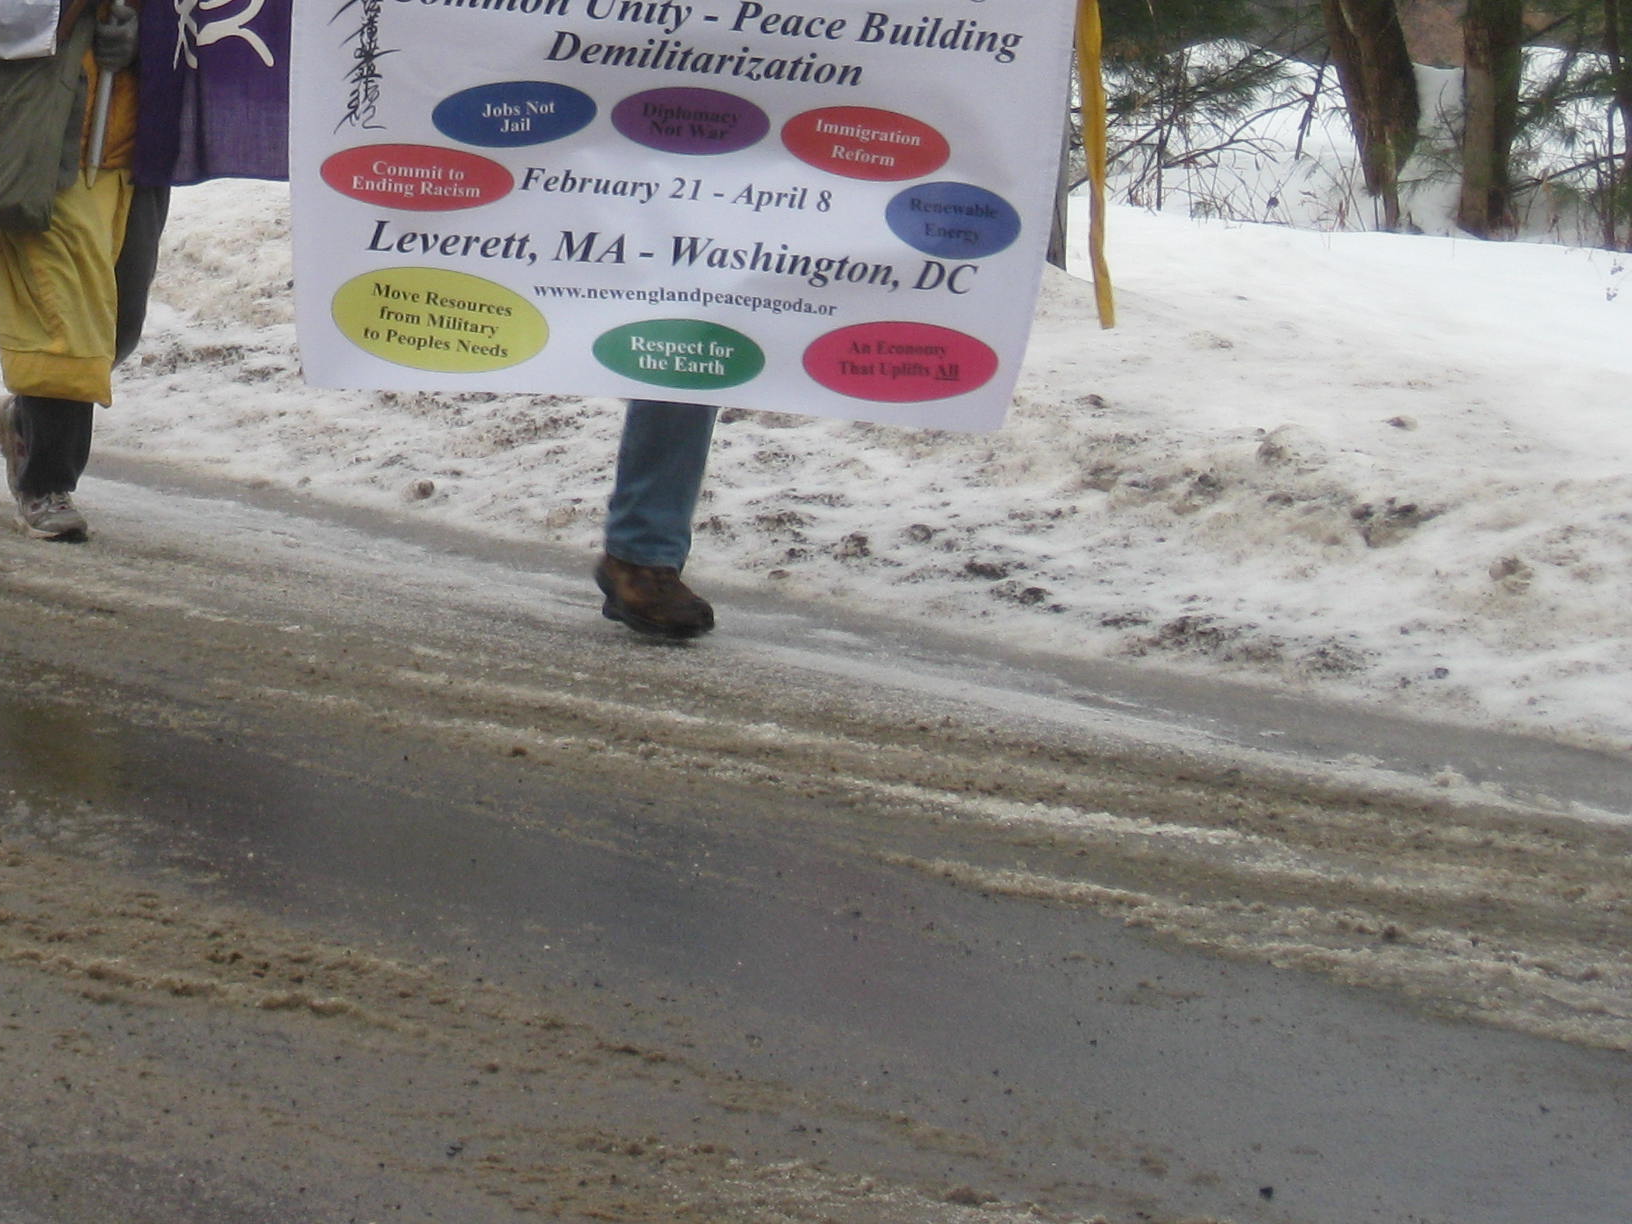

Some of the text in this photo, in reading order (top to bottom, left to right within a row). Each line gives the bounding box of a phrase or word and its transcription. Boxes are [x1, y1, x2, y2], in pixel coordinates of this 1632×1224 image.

[729, 0, 848, 41] Peace
[858, 11, 1024, 64] Building
[543, 30, 864, 87] Demilitarization
[481, 100, 556, 118] Jobs Not
[642, 102, 742, 127] Diplomacy
[500, 118, 531, 133] Jail
[649, 121, 729, 140] Not War
[815, 119, 921, 147] Immigration
[831, 145, 896, 168] Reform
[371, 161, 465, 181] Commit to
[351, 176, 481, 199] Ending Racism
[519, 167, 660, 204] February
[669, 176, 701, 202] 21
[732, 182, 807, 212] April
[816, 189, 833, 213] 8
[909, 198, 999, 220] Renewable
[924, 223, 980, 245] Energy
[365, 219, 538, 266] Leverett,
[552, 230, 627, 264] MA
[670, 235, 900, 293] Washington,
[913, 260, 979, 295] DC
[371, 282, 513, 318] Move Resources
[379, 306, 499, 339] from Military
[363, 326, 509, 359] to Peoples Needs
[630, 335, 736, 359] Respect for
[849, 341, 948, 359] An Economy
[638, 355, 726, 376] the Earth
[839, 361, 960, 380] That Uplifts All
